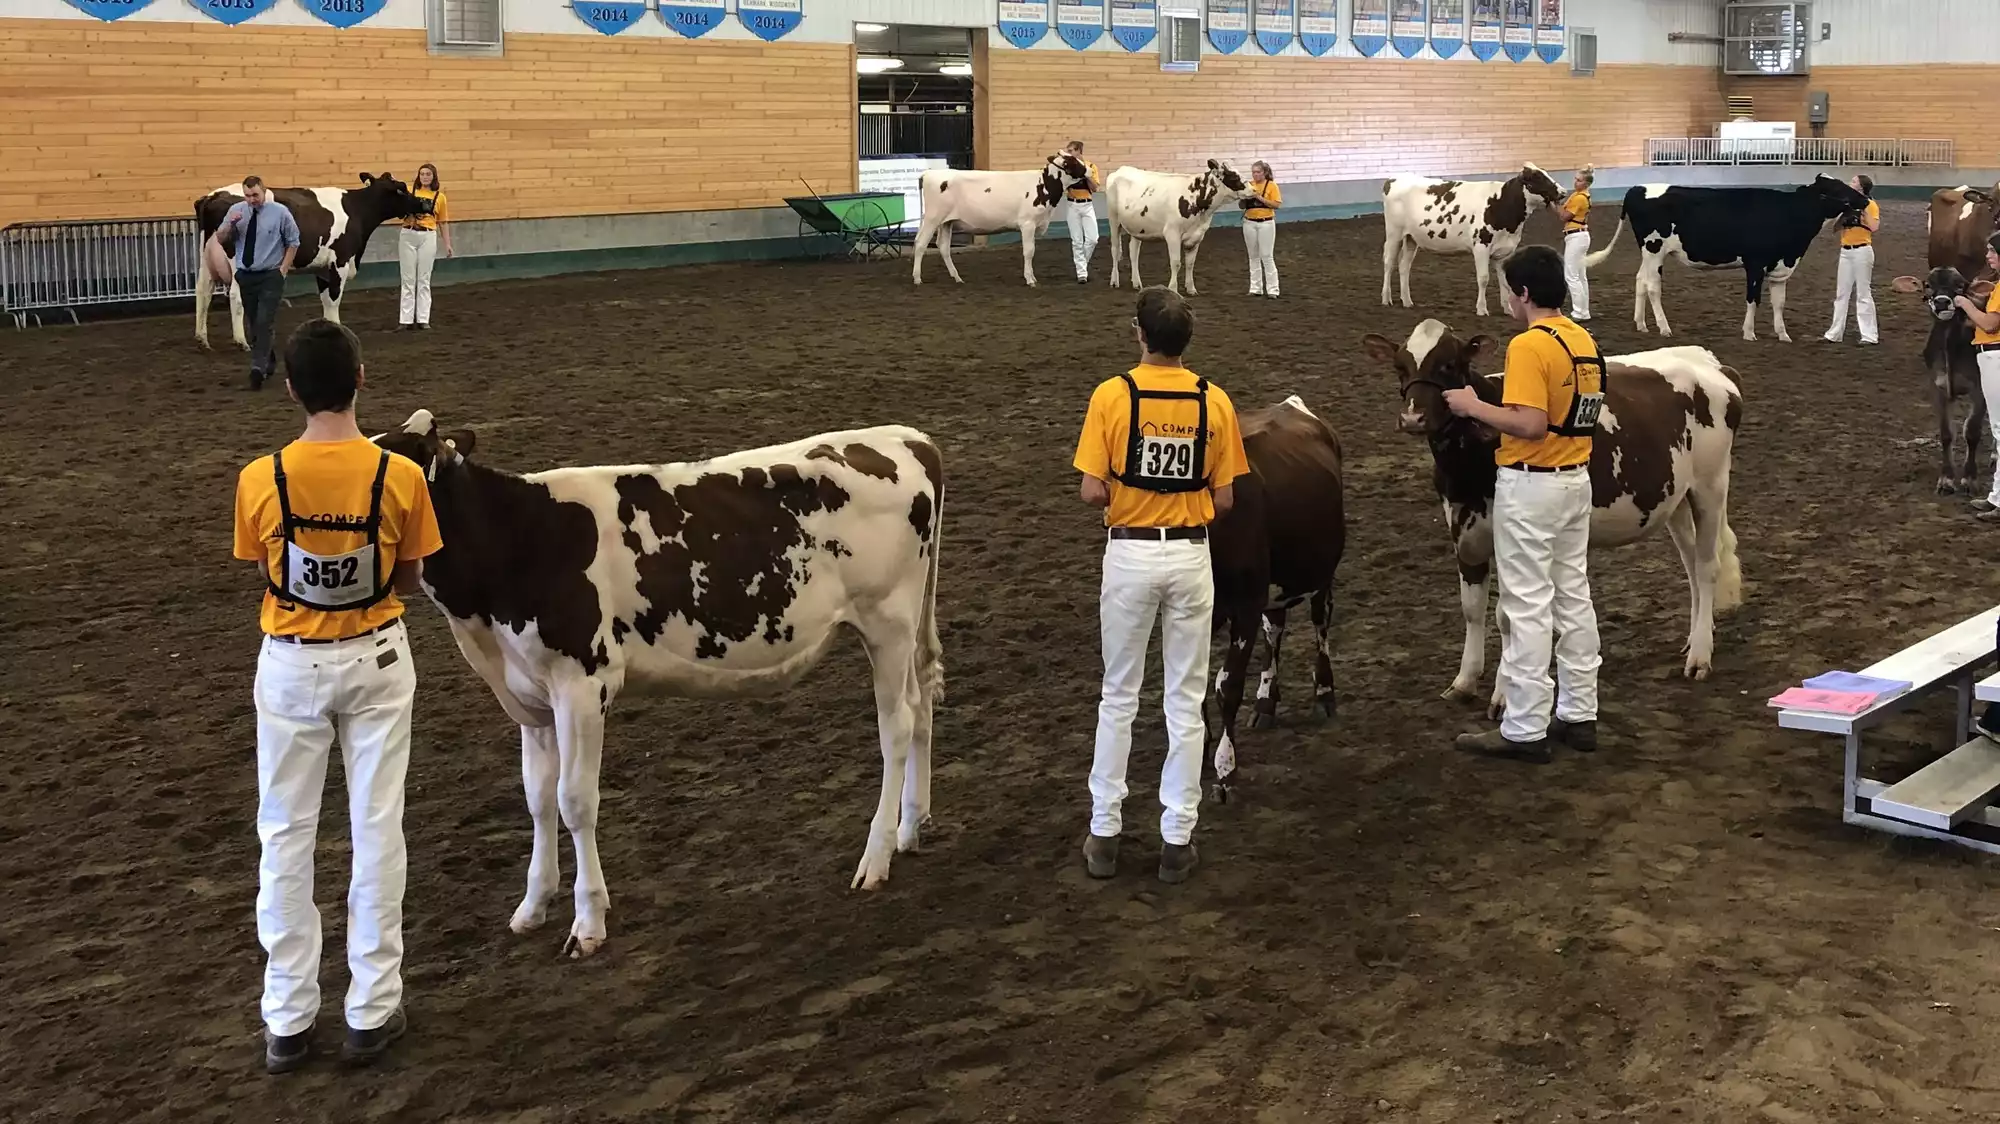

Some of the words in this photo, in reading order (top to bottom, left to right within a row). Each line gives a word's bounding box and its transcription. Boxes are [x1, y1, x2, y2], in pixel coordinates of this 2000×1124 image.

[321, 0, 364, 13] 2013
[591, 8, 629, 22] 2014
[674, 11, 709, 26] 2014
[753, 15, 787, 29] 2014
[1011, 26, 1035, 39] 2015
[1068, 28, 1092, 40] 2015
[1123, 31, 1145, 42] 2015
[1147, 442, 1190, 477] 329
[303, 556, 358, 589] 352
